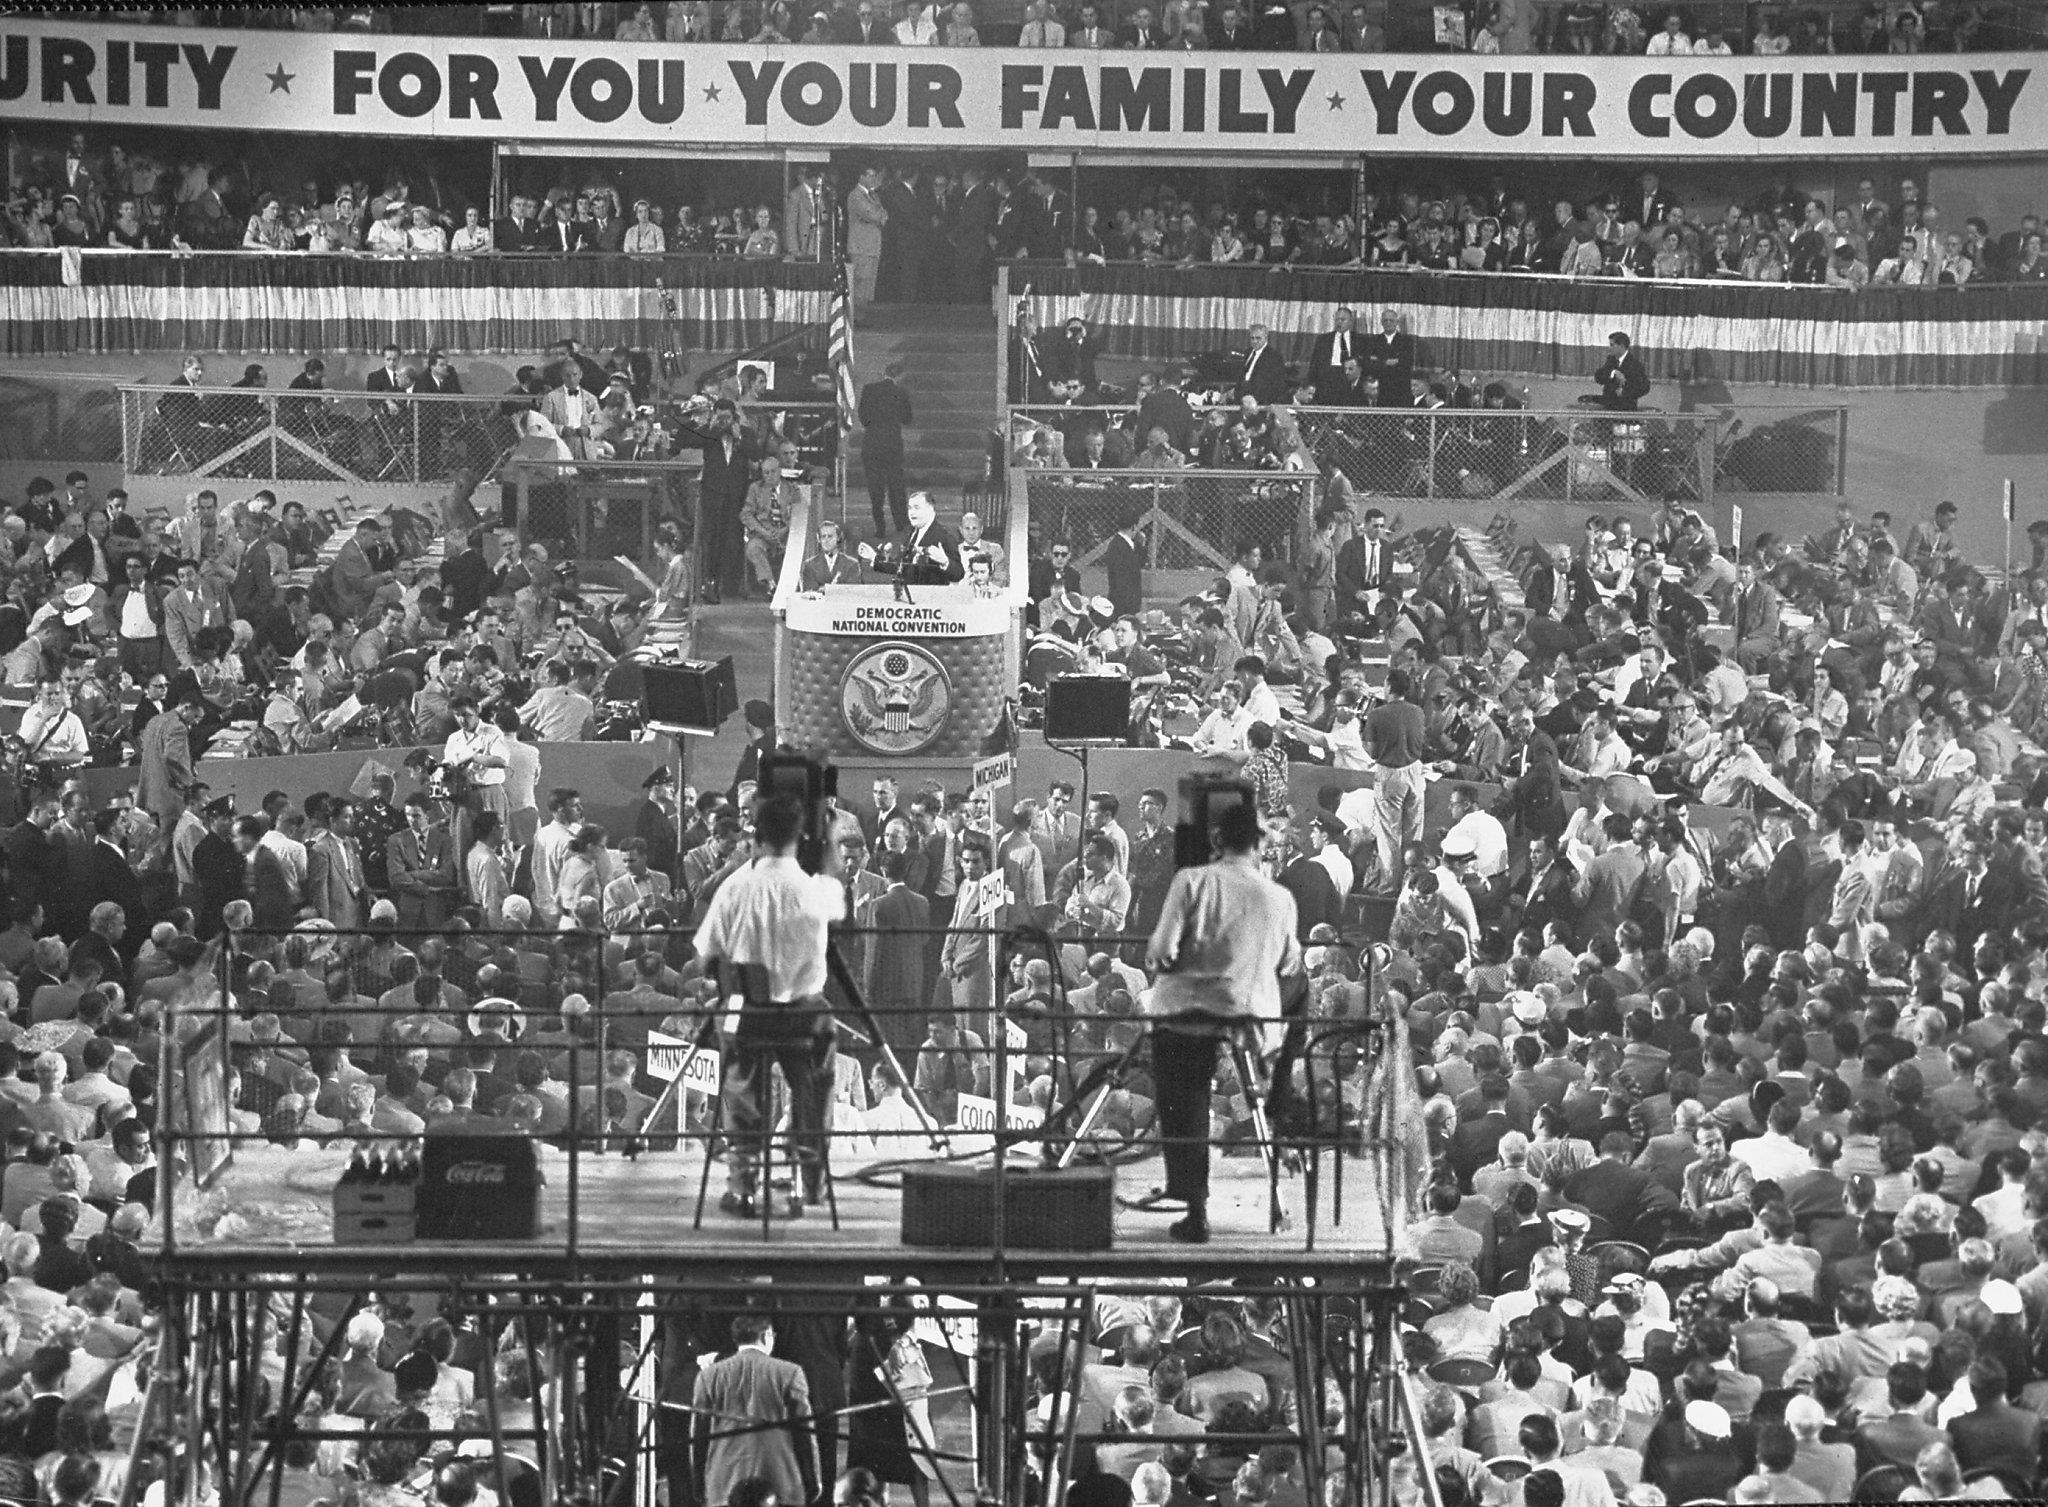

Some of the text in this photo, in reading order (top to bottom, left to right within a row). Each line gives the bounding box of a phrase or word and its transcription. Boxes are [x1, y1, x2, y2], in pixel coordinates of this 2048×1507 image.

[0, 34, 2032, 140] URITY FOR YOU YOUR FAMILY YOUR COUNTRY
[856, 607, 942, 620] DEMOCRATIC
[832, 620, 966, 634] NATIONAL CONVENTION
[975, 759, 1009, 785] MICHIGAN
